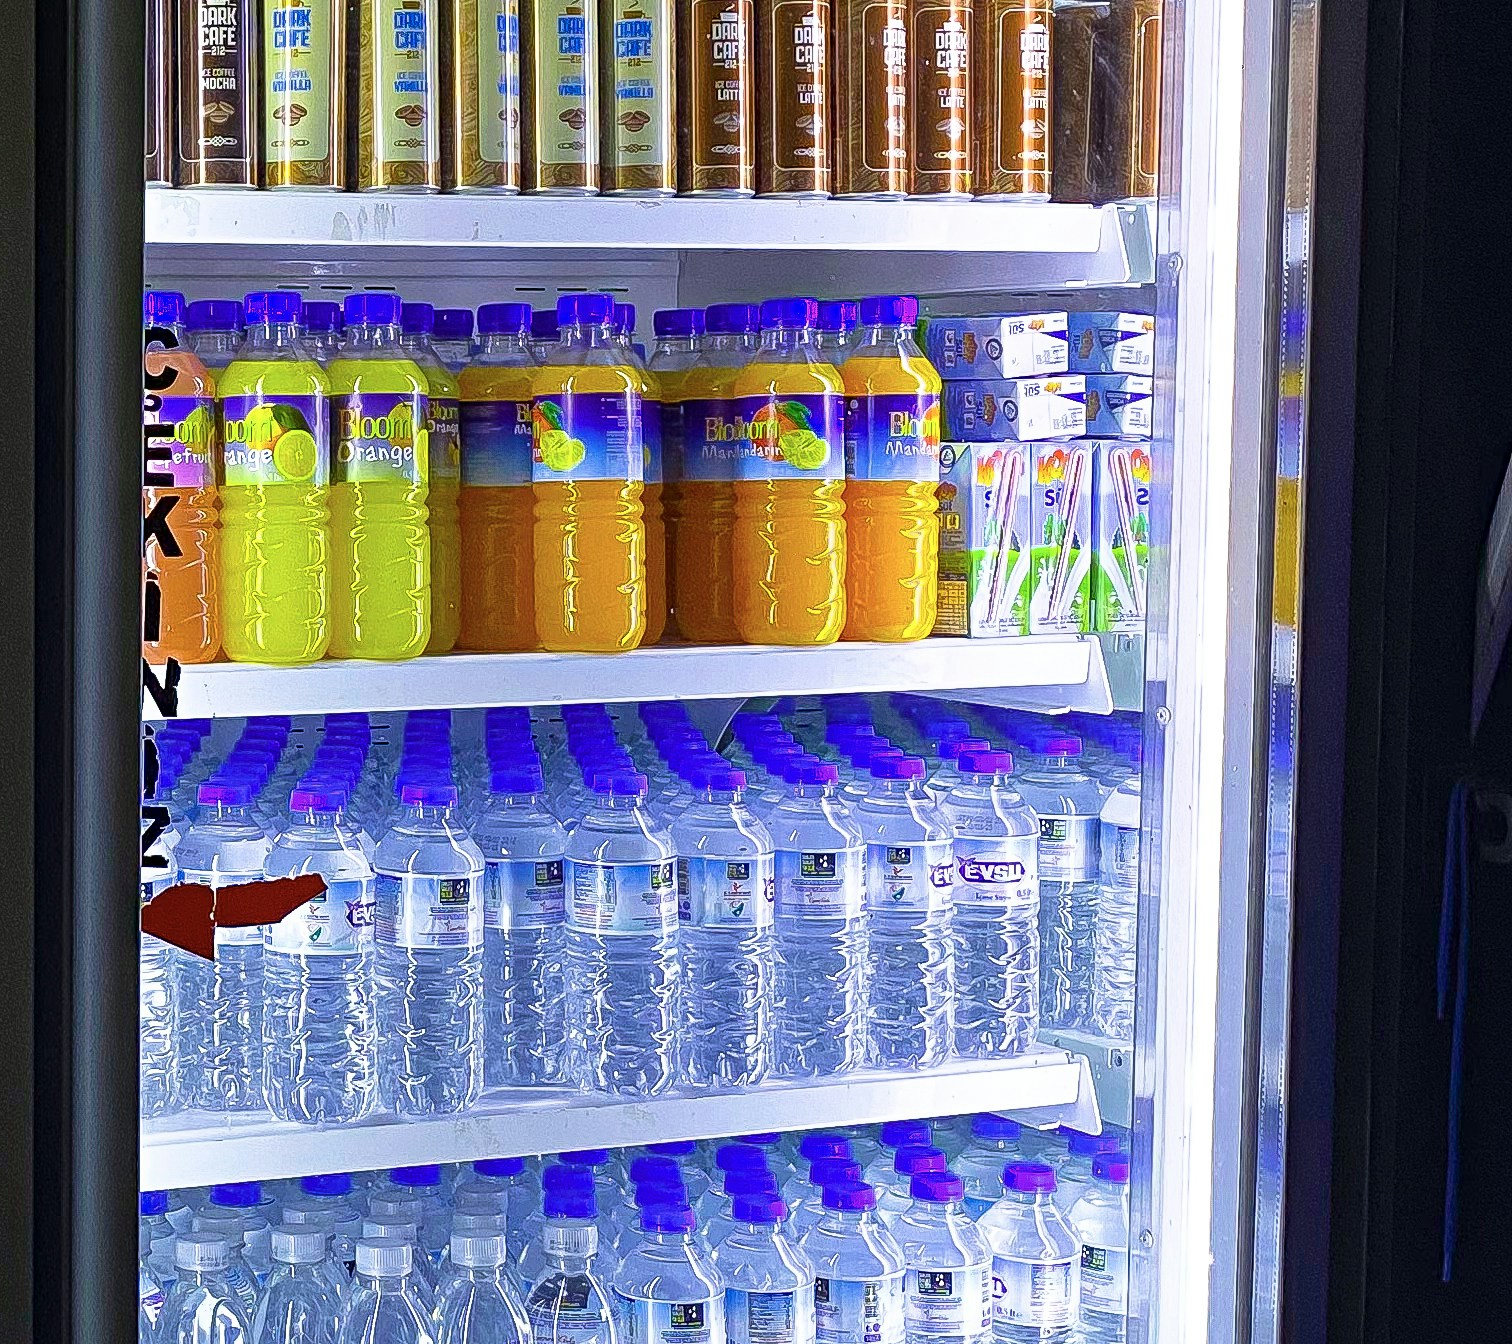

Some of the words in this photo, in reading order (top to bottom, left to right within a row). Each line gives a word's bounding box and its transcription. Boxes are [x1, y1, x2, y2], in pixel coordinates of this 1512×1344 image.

[340, 409, 412, 439] Bloom
[337, 446, 413, 466] Orange
[964, 861, 1021, 882] EVSU
